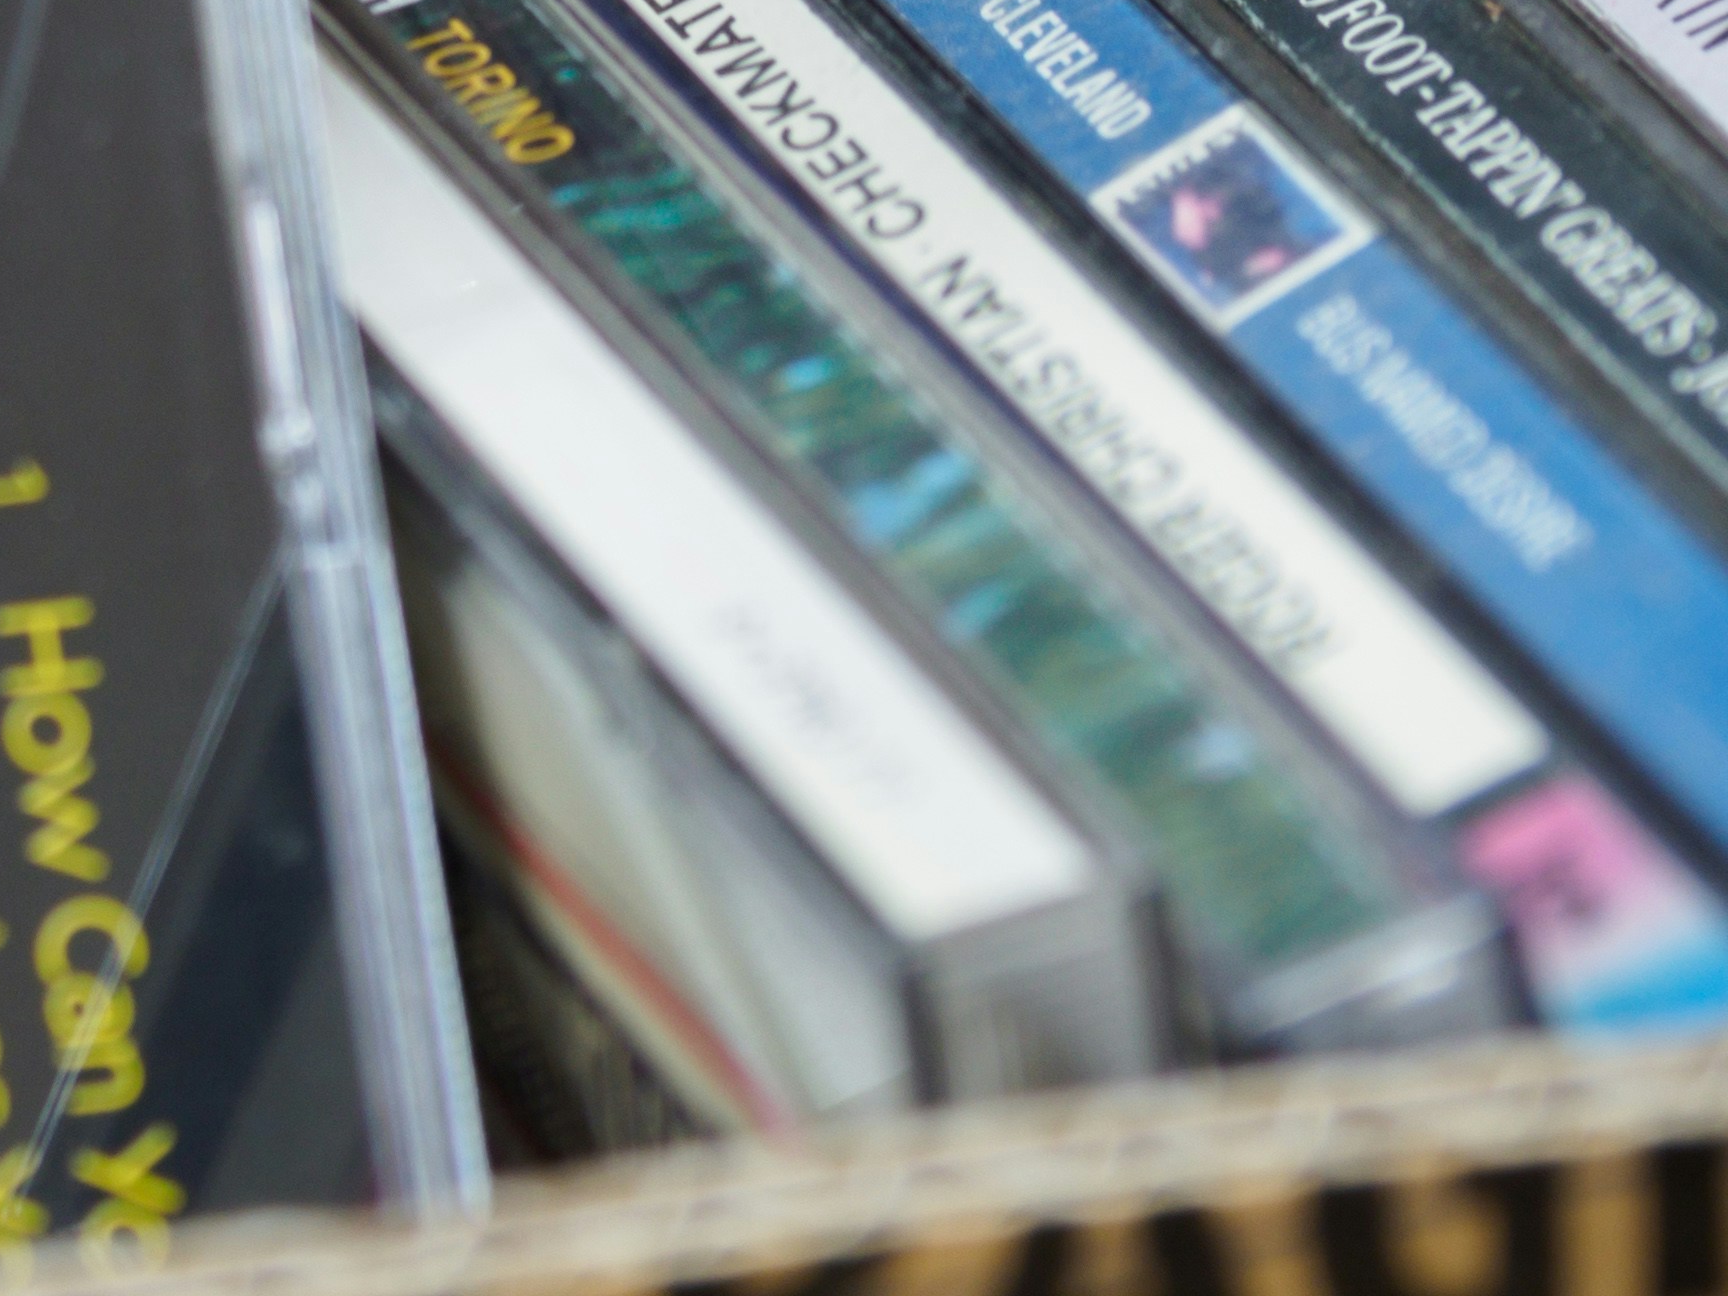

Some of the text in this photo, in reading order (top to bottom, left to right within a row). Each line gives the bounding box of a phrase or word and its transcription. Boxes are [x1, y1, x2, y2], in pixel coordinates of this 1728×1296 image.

[407, 18, 575, 165] TORINO
[919, 255, 1182, 496] CHRISTIAN
[34, 894, 150, 1115] Can
